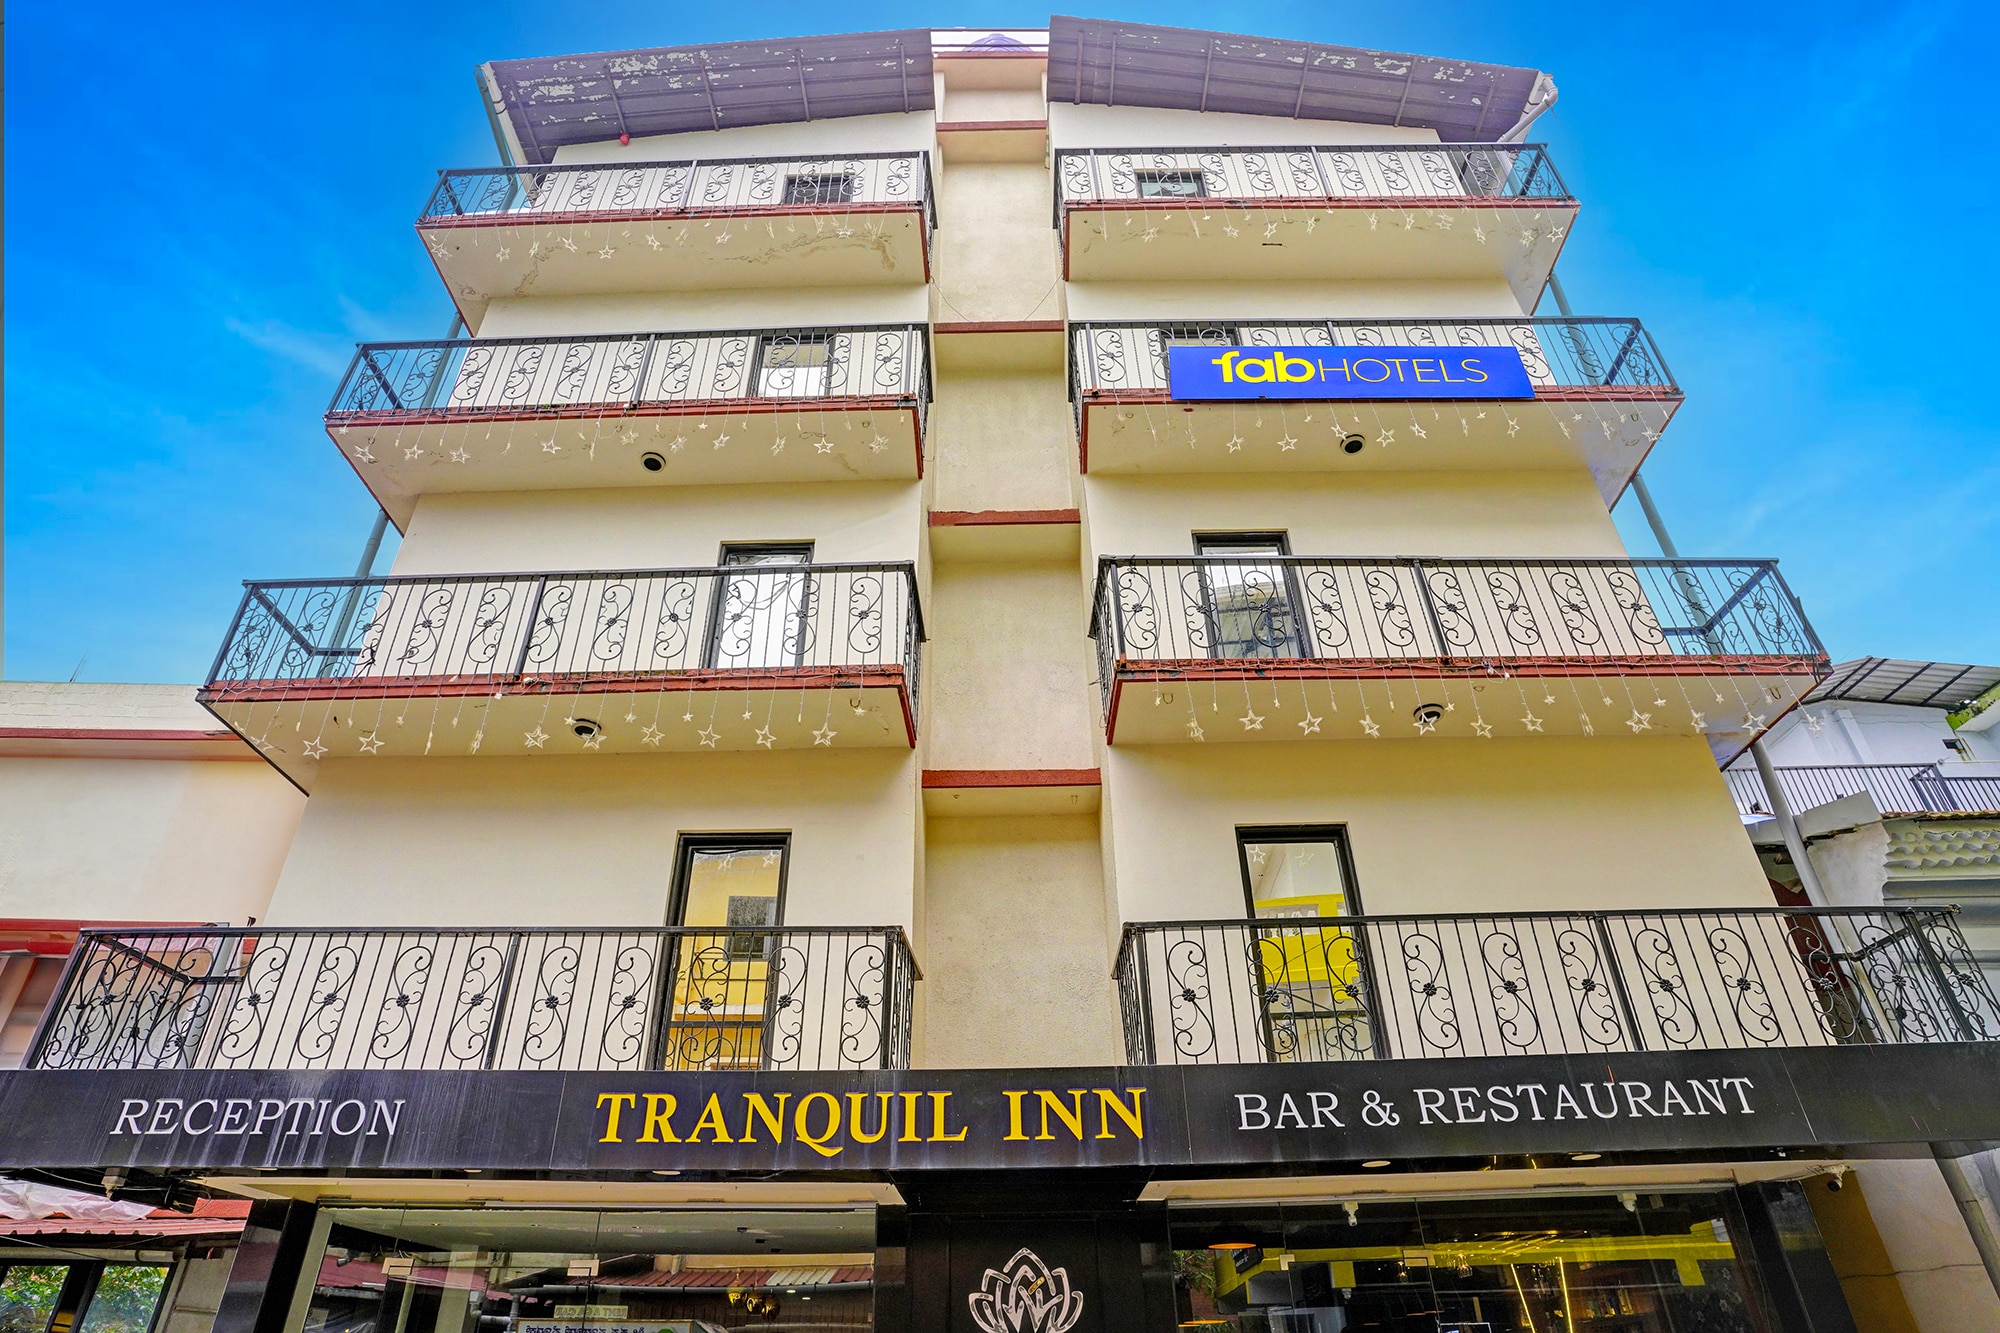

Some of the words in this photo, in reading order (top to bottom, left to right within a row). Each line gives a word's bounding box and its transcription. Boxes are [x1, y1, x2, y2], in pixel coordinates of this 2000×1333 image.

[109, 1097, 406, 1136] RECEPTION
[595, 1090, 969, 1158] TRANQUIL
[1002, 1086, 1147, 1142] INN
[1234, 1091, 1346, 1131] BAR
[1361, 1090, 1401, 1127] &
[1412, 1076, 1756, 1126] RESTAURANT
